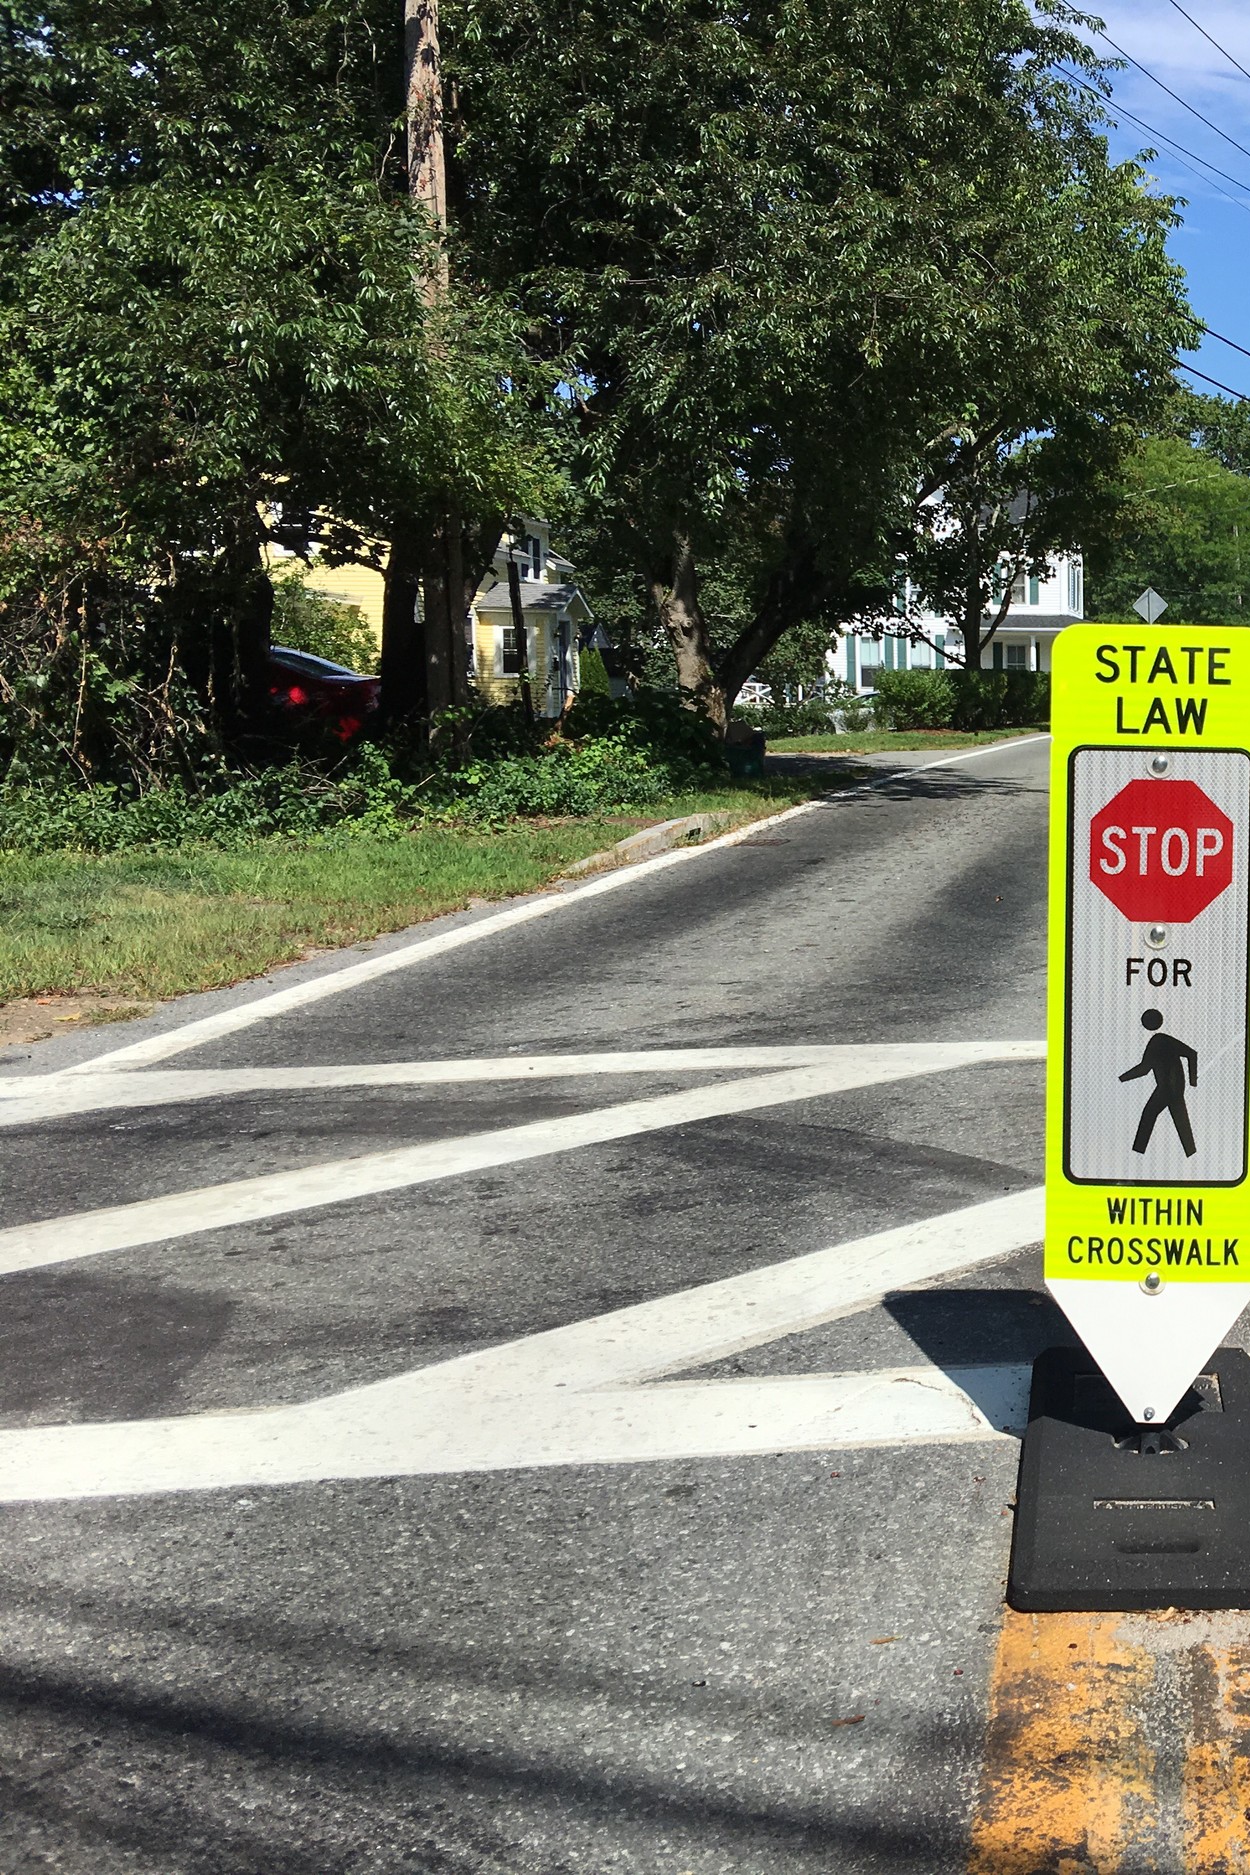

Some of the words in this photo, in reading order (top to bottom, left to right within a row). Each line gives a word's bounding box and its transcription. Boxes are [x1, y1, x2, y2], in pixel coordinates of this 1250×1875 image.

[1095, 644, 1232, 685] STATE
[1116, 696, 1208, 735] LAW
[1099, 825, 1224, 877] STOP
[1126, 957, 1192, 987] FOR
[1107, 1197, 1204, 1226] WITHIN
[1068, 1235, 1240, 1266] CROSSWALK
